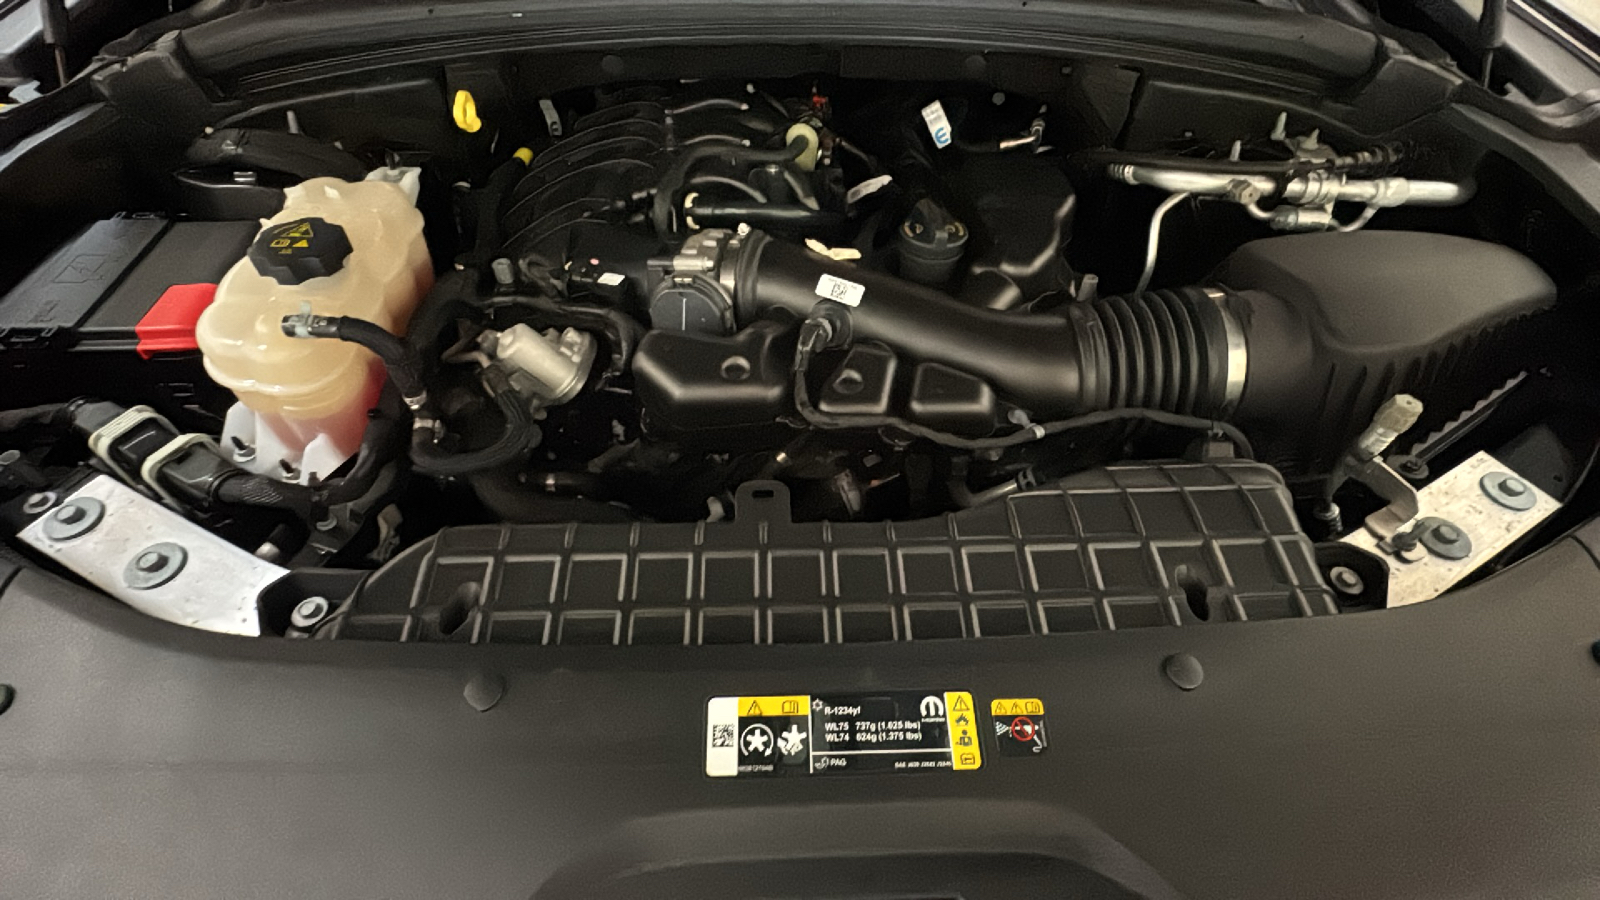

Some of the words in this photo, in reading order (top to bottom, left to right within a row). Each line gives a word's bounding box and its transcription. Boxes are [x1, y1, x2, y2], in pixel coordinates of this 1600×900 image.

[824, 721, 849, 732] WL75
[854, 721, 876, 732] 737g
[824, 732, 850, 742] WL74
